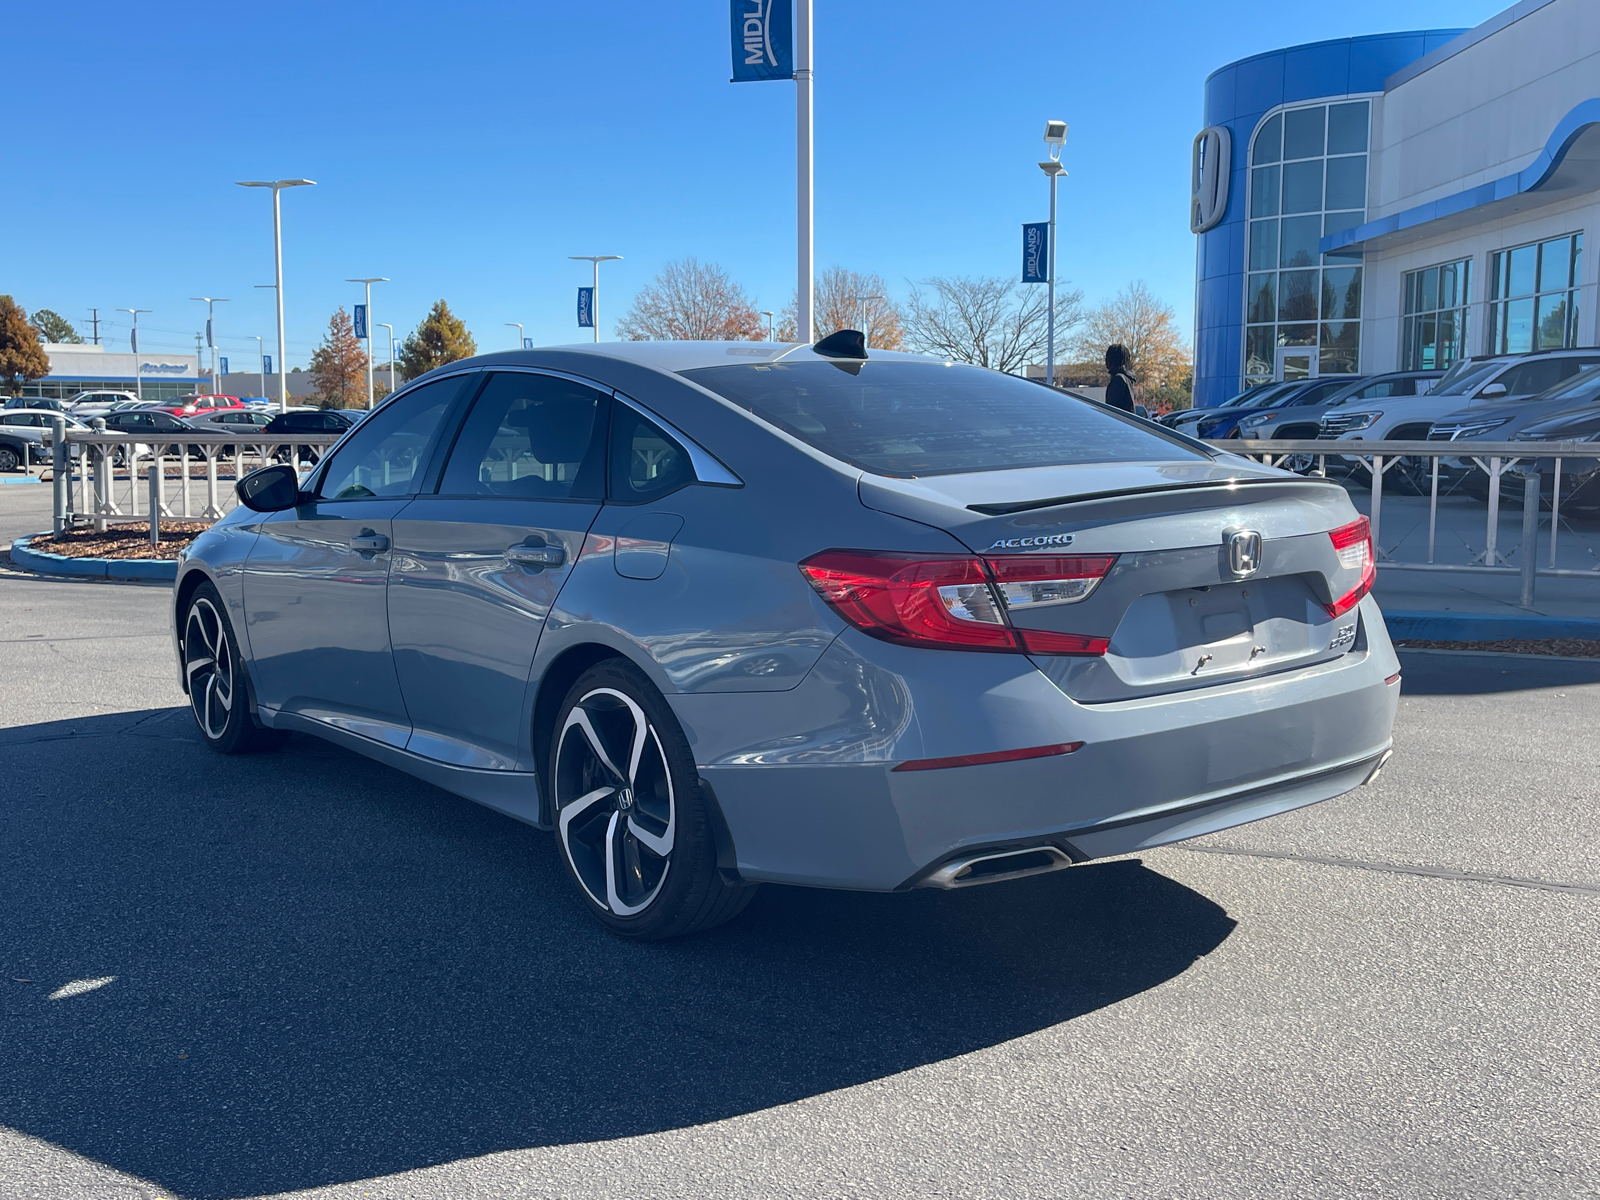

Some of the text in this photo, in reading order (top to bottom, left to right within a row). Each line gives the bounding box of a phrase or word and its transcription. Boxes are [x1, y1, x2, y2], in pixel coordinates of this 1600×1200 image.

[743, 0, 764, 65] MIDL
[1027, 227, 1037, 277] MIDLANDS
[990, 534, 1076, 549] ACCORD
